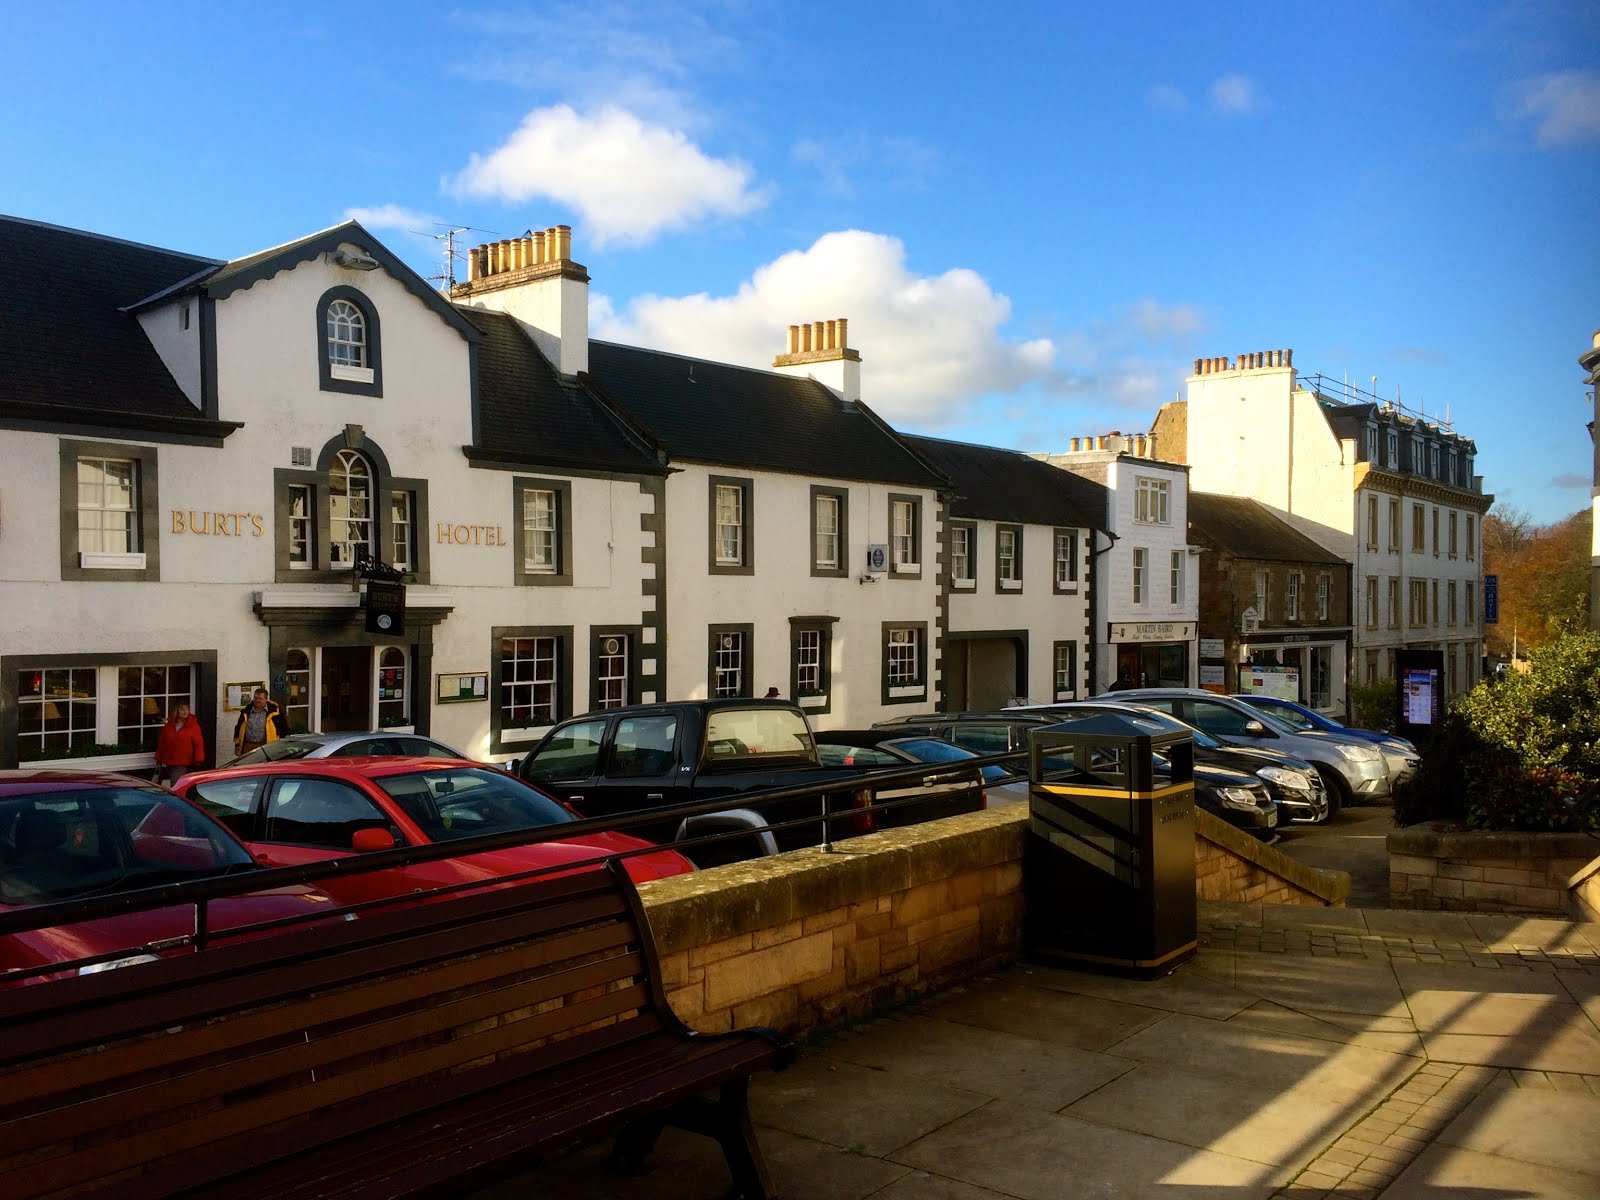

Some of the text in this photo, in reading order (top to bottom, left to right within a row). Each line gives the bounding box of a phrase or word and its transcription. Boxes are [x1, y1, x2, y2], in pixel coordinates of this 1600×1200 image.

[171, 510, 506, 546] BURT'S HOTEL
[1136, 624, 1174, 634] MARTIN BAIRD
